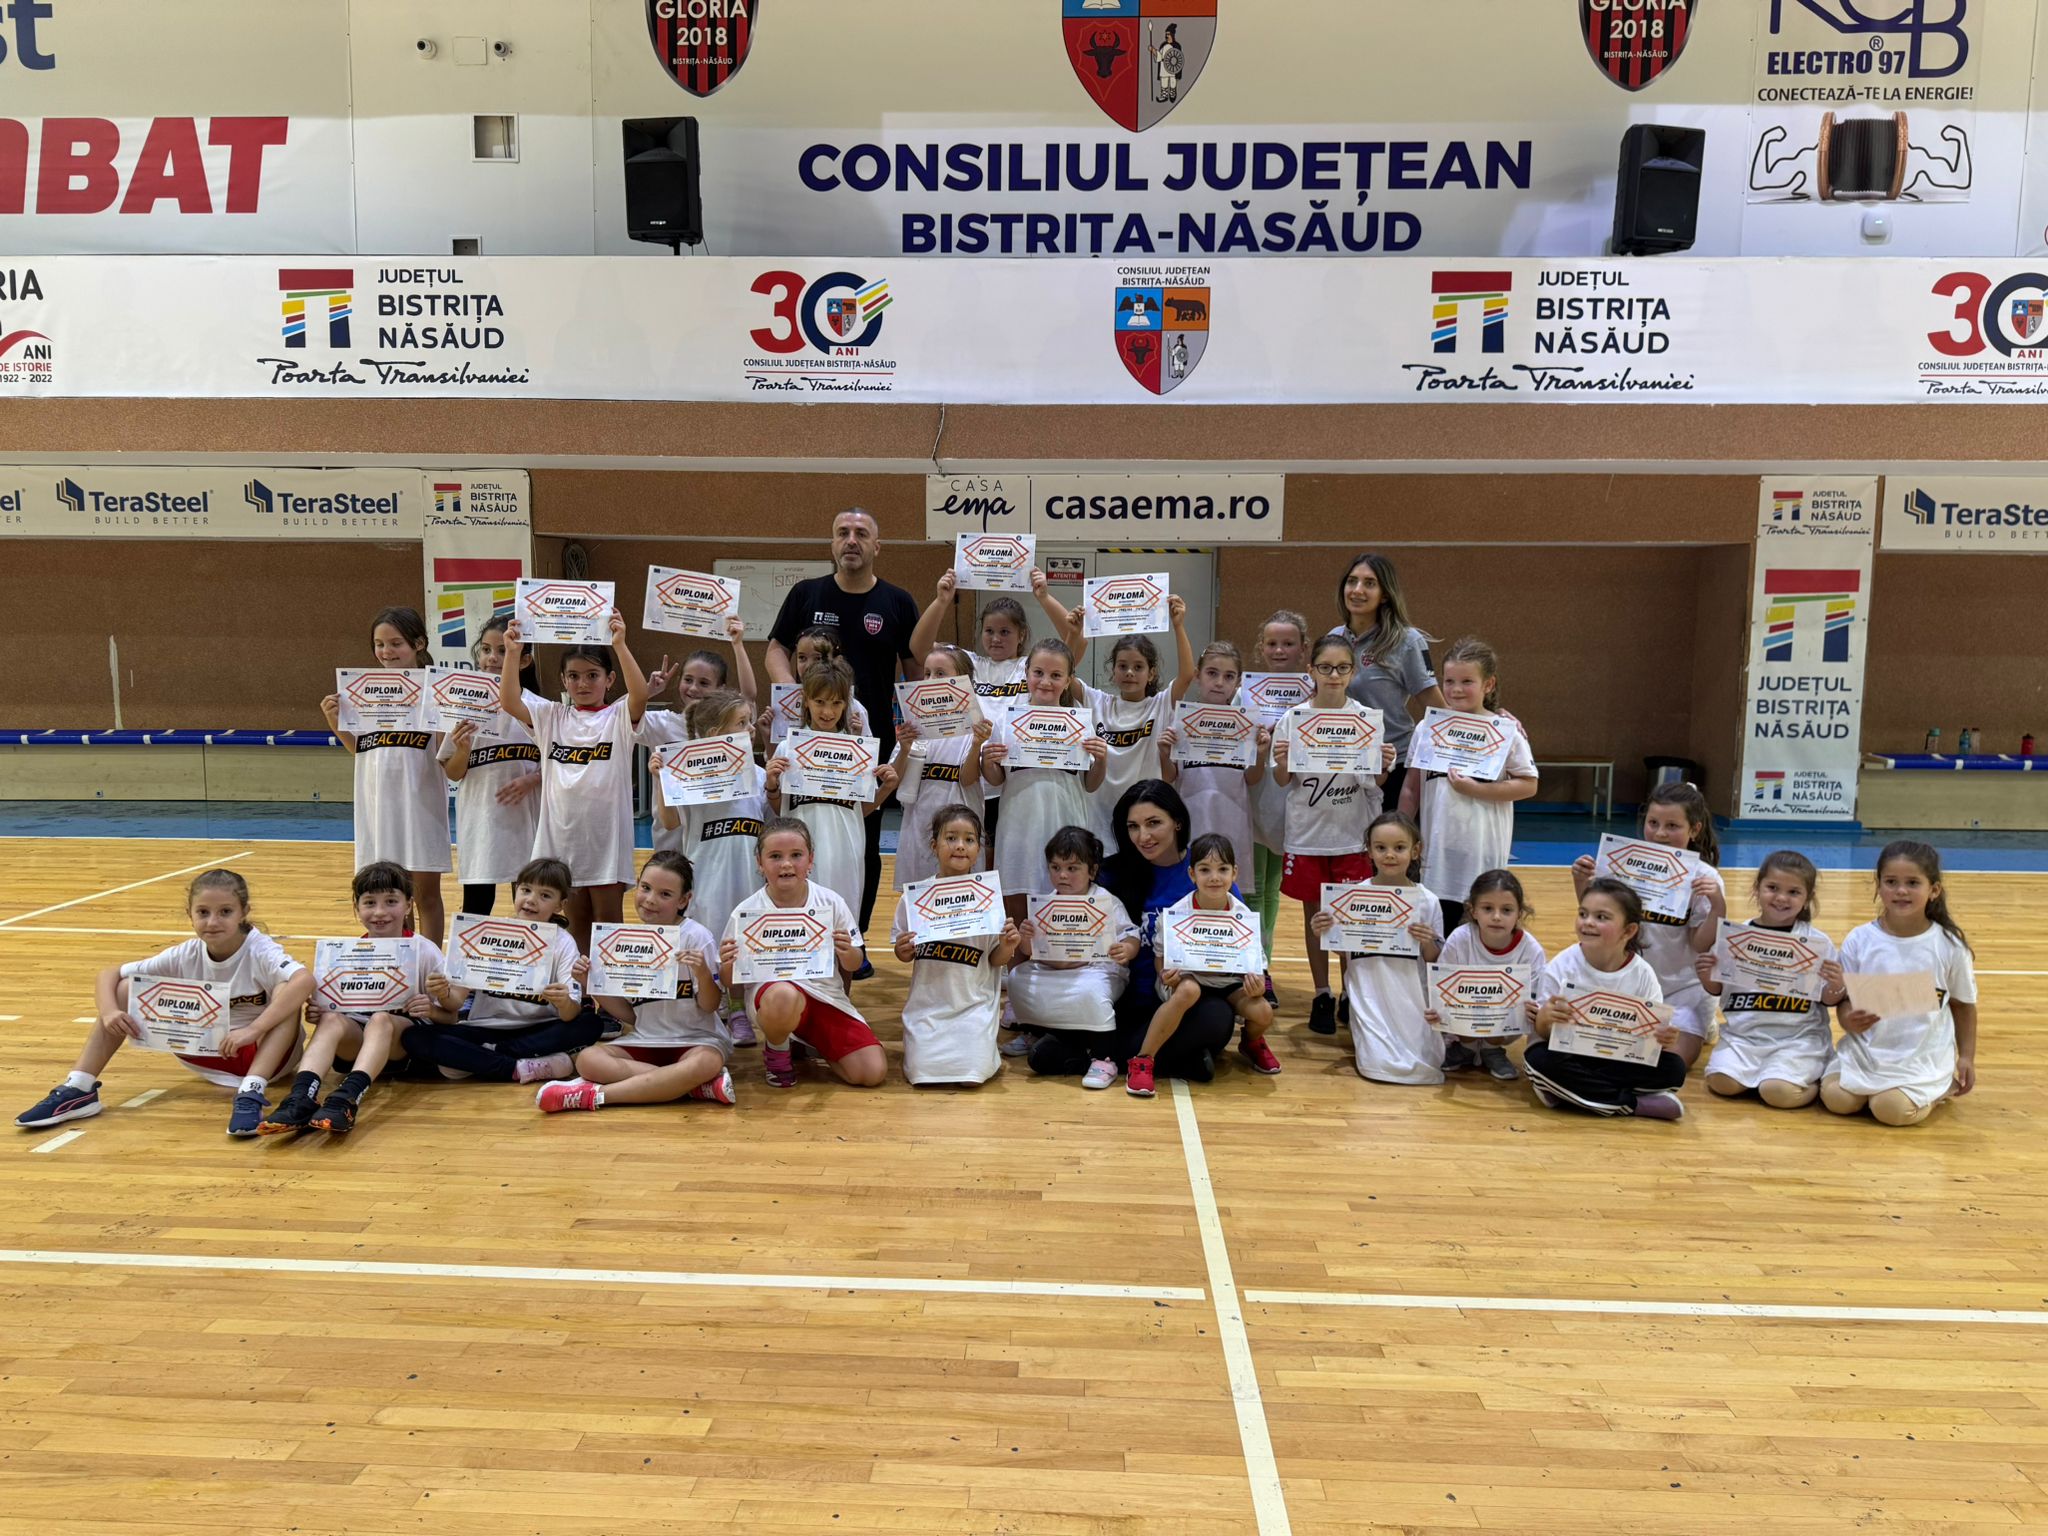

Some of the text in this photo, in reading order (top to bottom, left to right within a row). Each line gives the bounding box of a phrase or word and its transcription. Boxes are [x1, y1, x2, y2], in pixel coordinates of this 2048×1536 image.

[655, 0, 748, 18] GLORIA
[1610, 19, 1664, 39] 2018
[677, 27, 728, 46] 2018
[1767, 50, 1905, 75] ELECTRO 97
[1758, 85, 1973, 101] CONECTEAZĂ-TE LA ENERGIE!
[798, 141, 1532, 206] CONSILIUL JUDEȚEAN
[378, 269, 463, 287] JUDEȚUL
[1117, 267, 1211, 276] CONSILIUL JUDEȚEAN
[1122, 276, 1205, 287] BISTRIȚA-NĂSĂUD
[1538, 271, 1630, 290] JUDEȚUL
[378, 294, 504, 323] BISTRIȚA
[1536, 297, 1671, 327] BISTRIȚA
[378, 322, 505, 349] NĂSĂUD
[1535, 328, 1670, 354] NĂSĂUD
[23, 345, 52, 359] ANI
[836, 347, 859, 356] ANI
[2017, 349, 2042, 358] ANI
[13, 363, 52, 372] ISTORIE
[257, 358, 365, 385] Poarta
[743, 359, 897, 370] CONSILIUL JUDEȚEAN BISTRIȚA-NĂSĂUD
[1918, 362, 1960, 370] CONSILIUL
[1963, 362, 2005, 372] JUDEȚEAN
[29, 374, 52, 383] 2022
[745, 376, 804, 391] Poarta
[1402, 364, 1518, 391] Poarta
[1919, 380, 1982, 394] Poarta
[951, 480, 1003, 492] CASA
[88, 491, 209, 512] TeraSteel
[277, 492, 398, 514] TeraSteel
[470, 492, 517, 503] BISTRIȚA
[1045, 494, 1270, 519] casaema.ro
[1812, 500, 1862, 511] BISTRIȚA
[933, 493, 1016, 533] ema
[95, 516, 209, 525] BUILD BETTER
[283, 517, 399, 527] BUILD BETTER
[1945, 530, 1996, 539] BUILD
[978, 547, 1013, 558] DIPLOMĂ
[544, 596, 587, 607] DIPLOMĂ
[674, 587, 714, 602] DIPLOMĂ
[1107, 589, 1145, 601] DIPLOMĂ
[364, 684, 403, 695] DIPLOMĂ
[449, 686, 489, 700] DIPLOMĂ
[1265, 687, 1301, 698] DIPLOMĂ
[1757, 676, 1852, 696] JUDEȚUL
[920, 694, 954, 706] DIPLOMĂ
[1756, 699, 1850, 720] BISTRIȚA
[1029, 722, 1067, 732] DIPLOMĂ
[1199, 720, 1236, 730] DIPLOMĂ
[1316, 726, 1356, 736] DIPLOMĂ
[1755, 720, 1849, 739] NĂSĂUD
[359, 732, 428, 749] #BEACTIVE
[1448, 728, 1486, 742] DIPLOMĂ
[469, 746, 540, 766] #BEACTIVE
[687, 754, 728, 768] DIPLOMĂ
[813, 750, 853, 762] DIPLOMĂ
[1793, 780, 1842, 791] BISTRIȚA
[1626, 857, 1669, 875] DIPLOMĂ
[935, 892, 976, 907] DIPLOMĂ
[1350, 903, 1392, 913] DIPLOMĂ
[1052, 912, 1089, 923] DIPLOMĂ
[762, 926, 806, 938] DIPLOMĂ
[1192, 926, 1234, 937] DIPLOMĂ
[480, 936, 526, 950] DIPLOMĂ
[615, 944, 654, 955] DIPLOMĂ
[1747, 943, 1795, 960] DIPLOMĂ
[1458, 984, 1503, 995] DIPLOMĂ
[157, 997, 200, 1012] DIPLOMĂ
[1589, 1005, 1638, 1022] DIPLOMĂ
